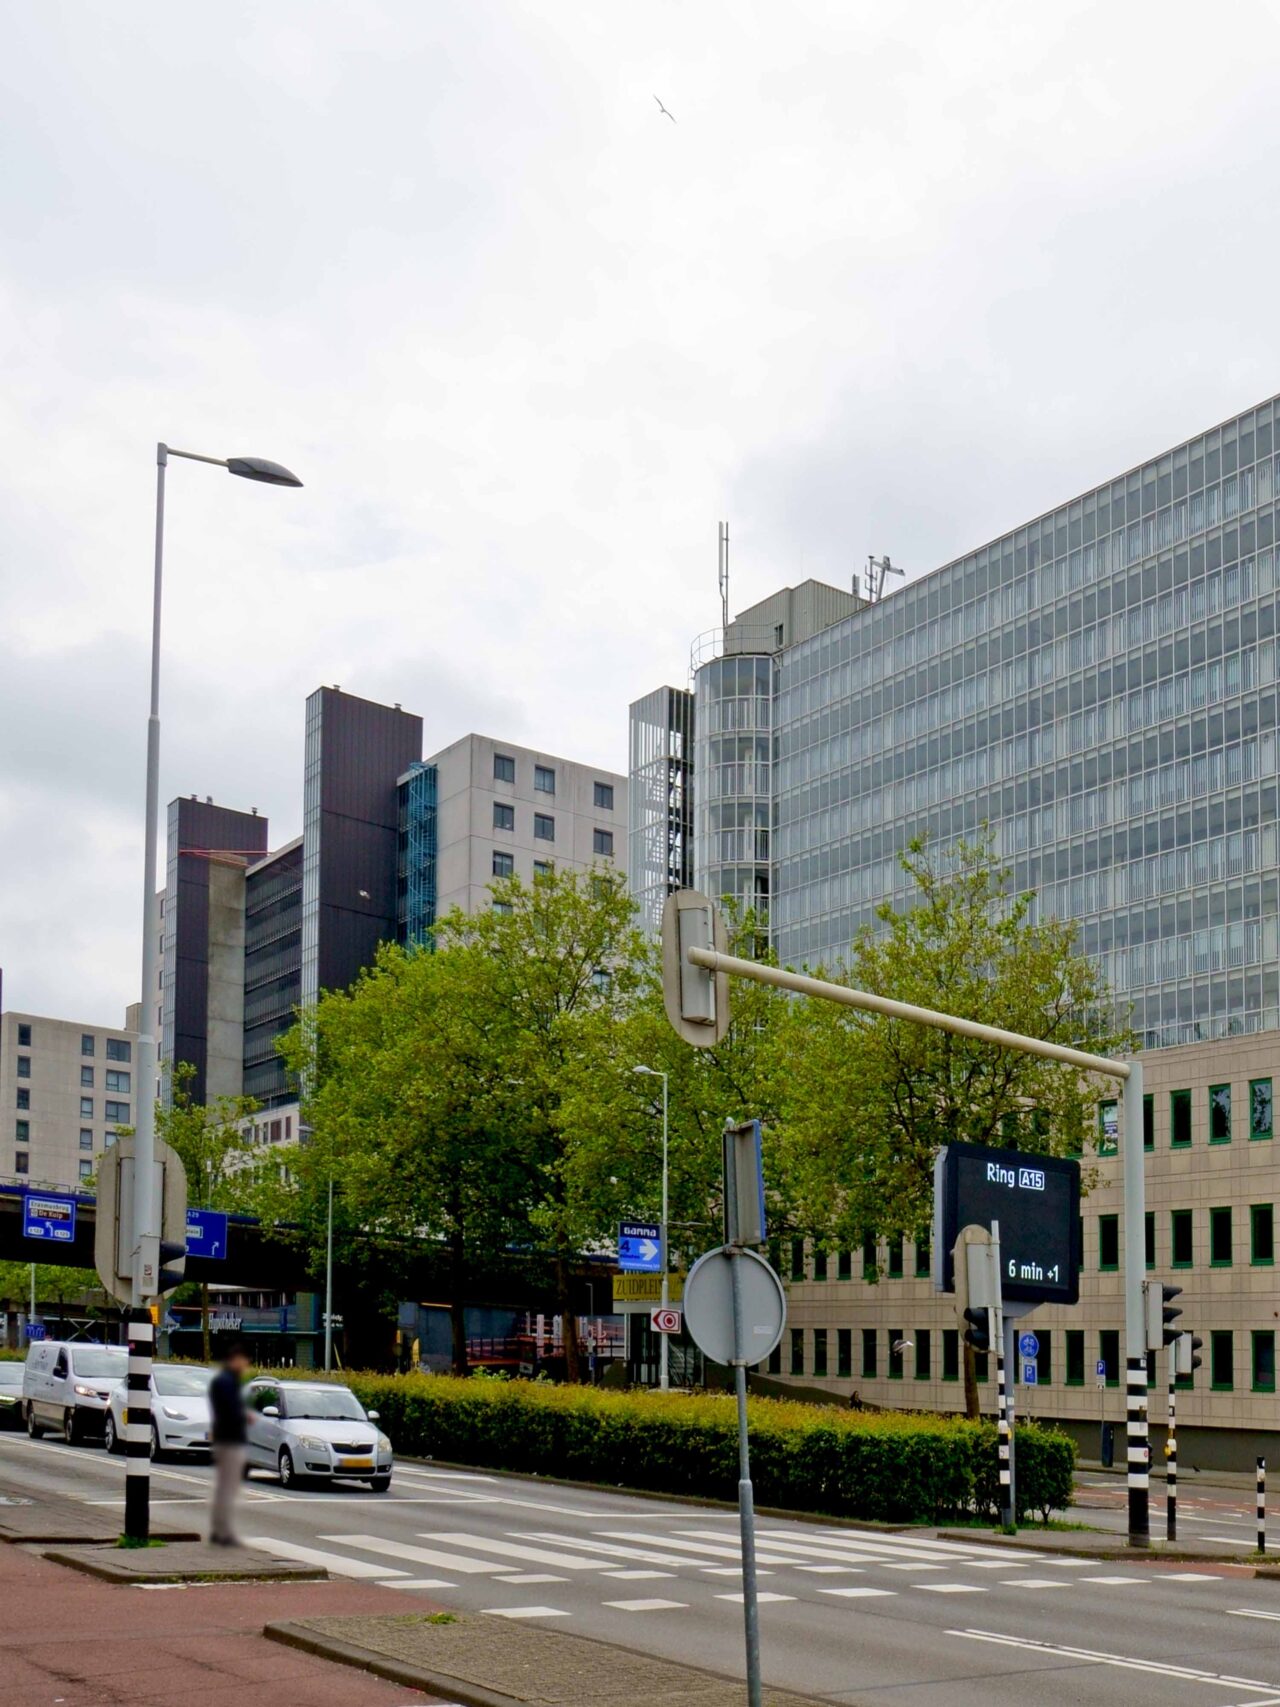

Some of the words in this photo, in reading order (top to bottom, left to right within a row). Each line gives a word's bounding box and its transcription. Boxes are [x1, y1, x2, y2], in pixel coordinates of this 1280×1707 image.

[987, 1163, 1015, 1188] Ring
[1022, 1172, 1042, 1187] A15
[620, 1240, 630, 1253] 4
[1008, 1260, 1016, 1277] 6
[1021, 1262, 1043, 1281] min
[1047, 1265, 1059, 1282] +1
[1026, 1366, 1033, 1378] P
[1098, 1362, 1104, 1374] P
